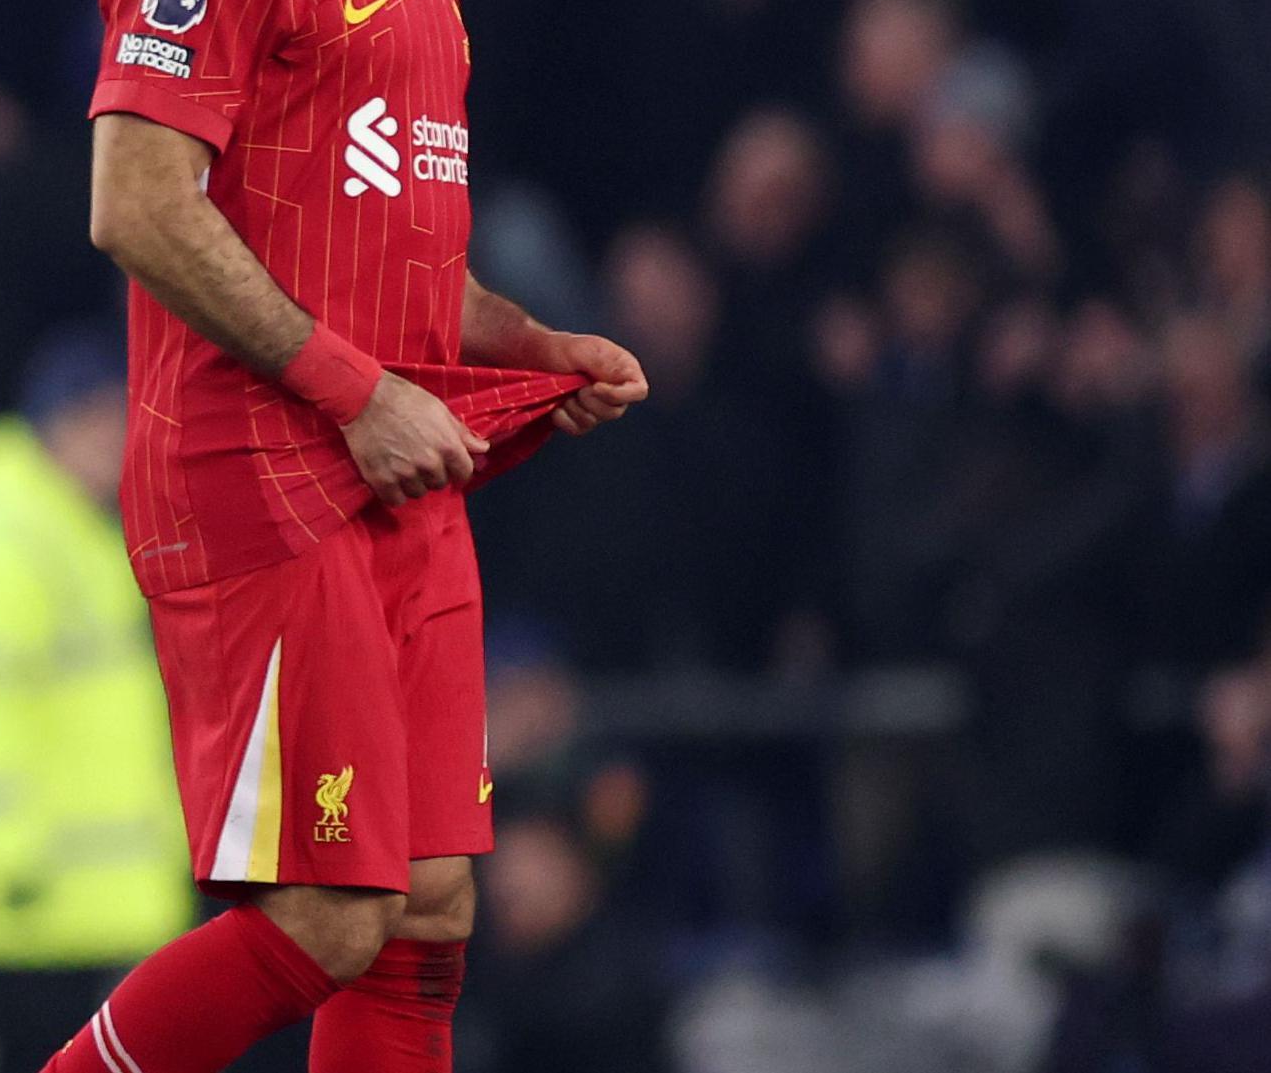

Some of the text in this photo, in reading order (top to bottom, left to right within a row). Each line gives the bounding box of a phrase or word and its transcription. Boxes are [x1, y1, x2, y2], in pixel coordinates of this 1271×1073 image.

[119, 33, 188, 62] No room
[138, 53, 191, 79] racism
